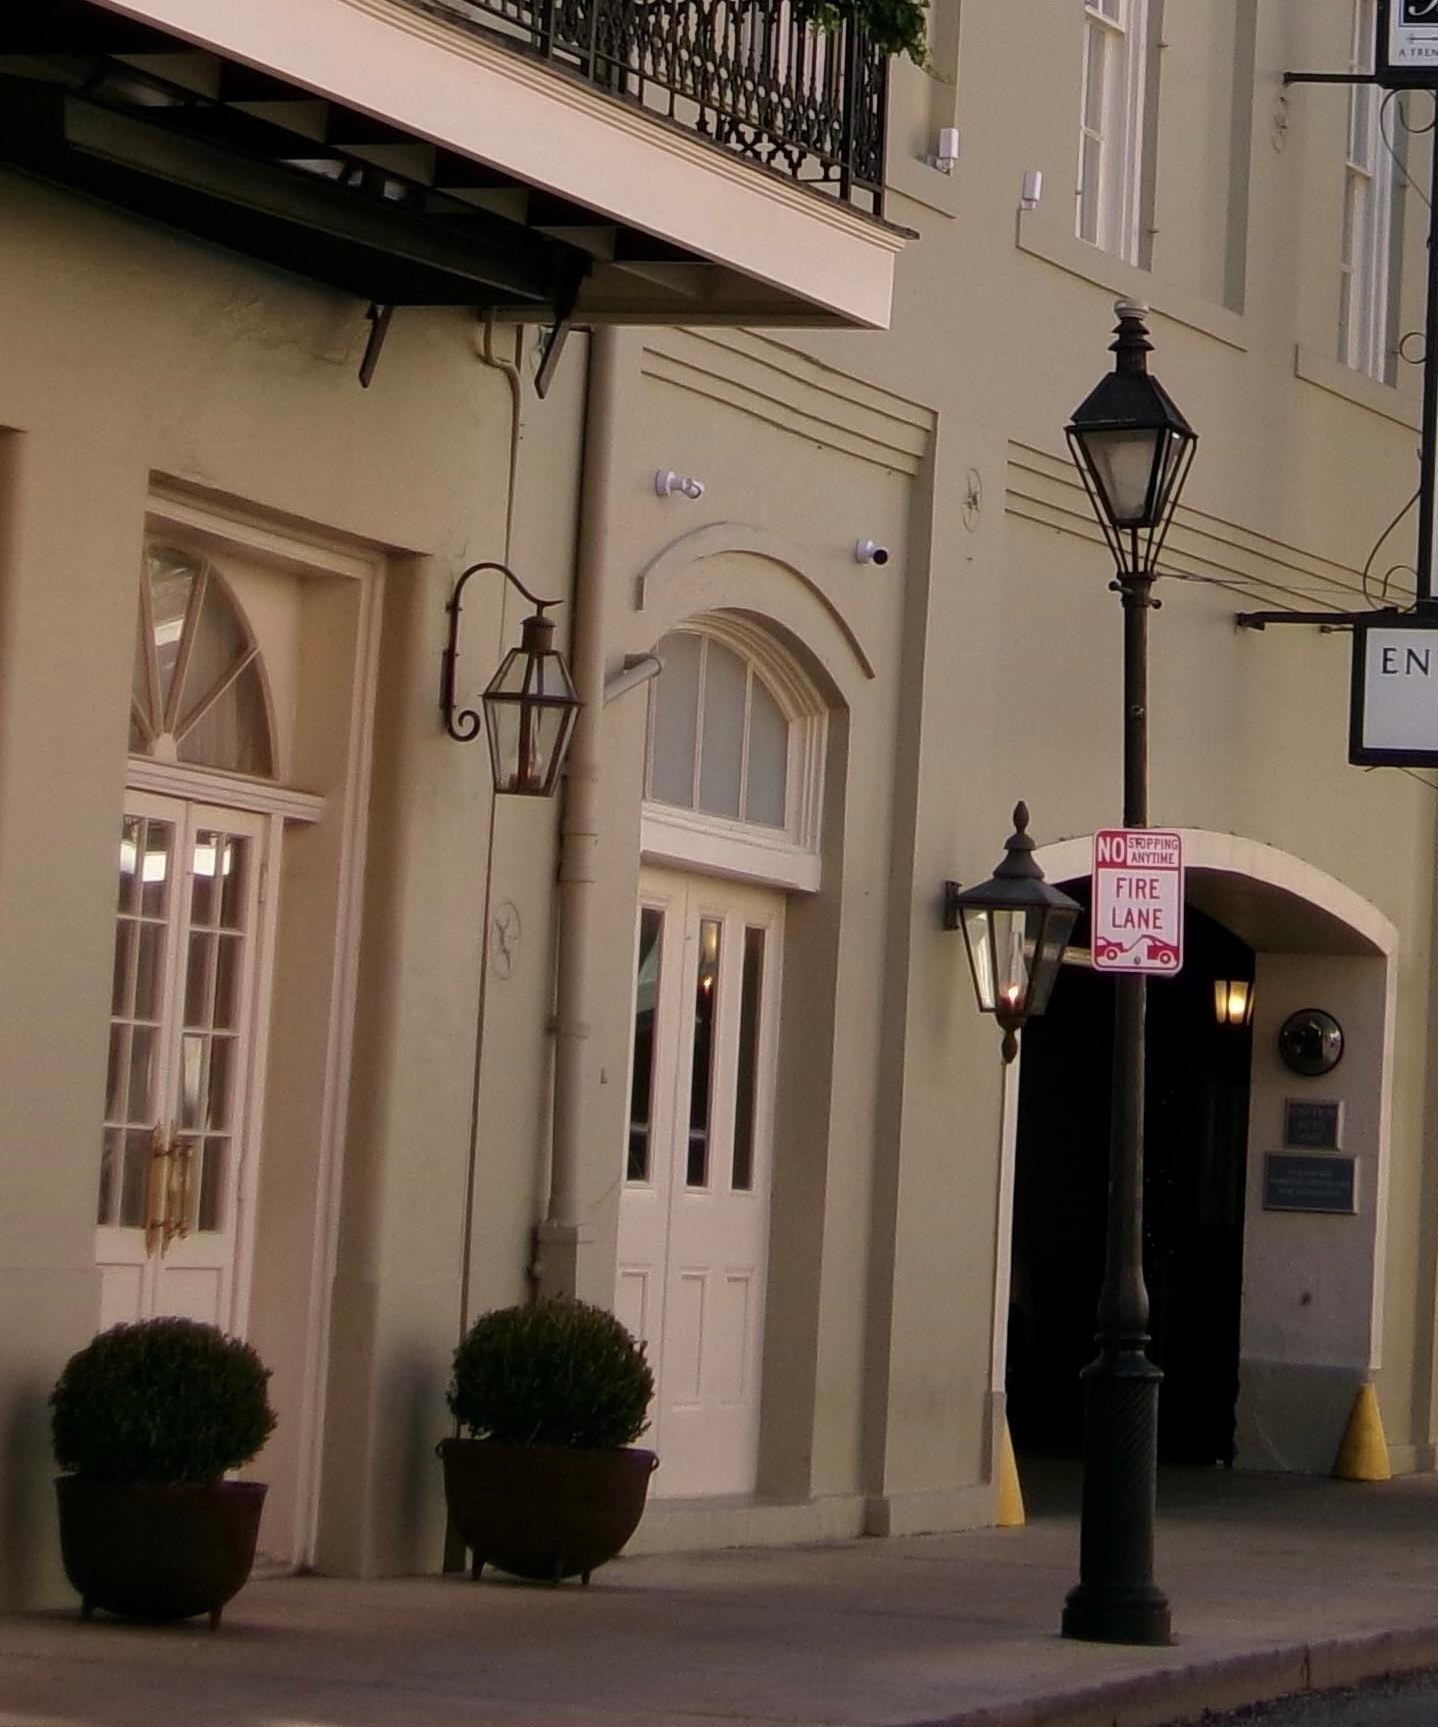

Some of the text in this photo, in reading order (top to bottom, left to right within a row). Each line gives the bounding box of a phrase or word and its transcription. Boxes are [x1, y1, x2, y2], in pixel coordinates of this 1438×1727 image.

[1399, 48, 1406, 57] A
[1098, 836, 1125, 863] NO
[1128, 837, 1178, 850] STOPPING
[1131, 852, 1175, 864] ANYTIME
[1116, 877, 1160, 899] FIRE
[1112, 907, 1163, 929] LANE
